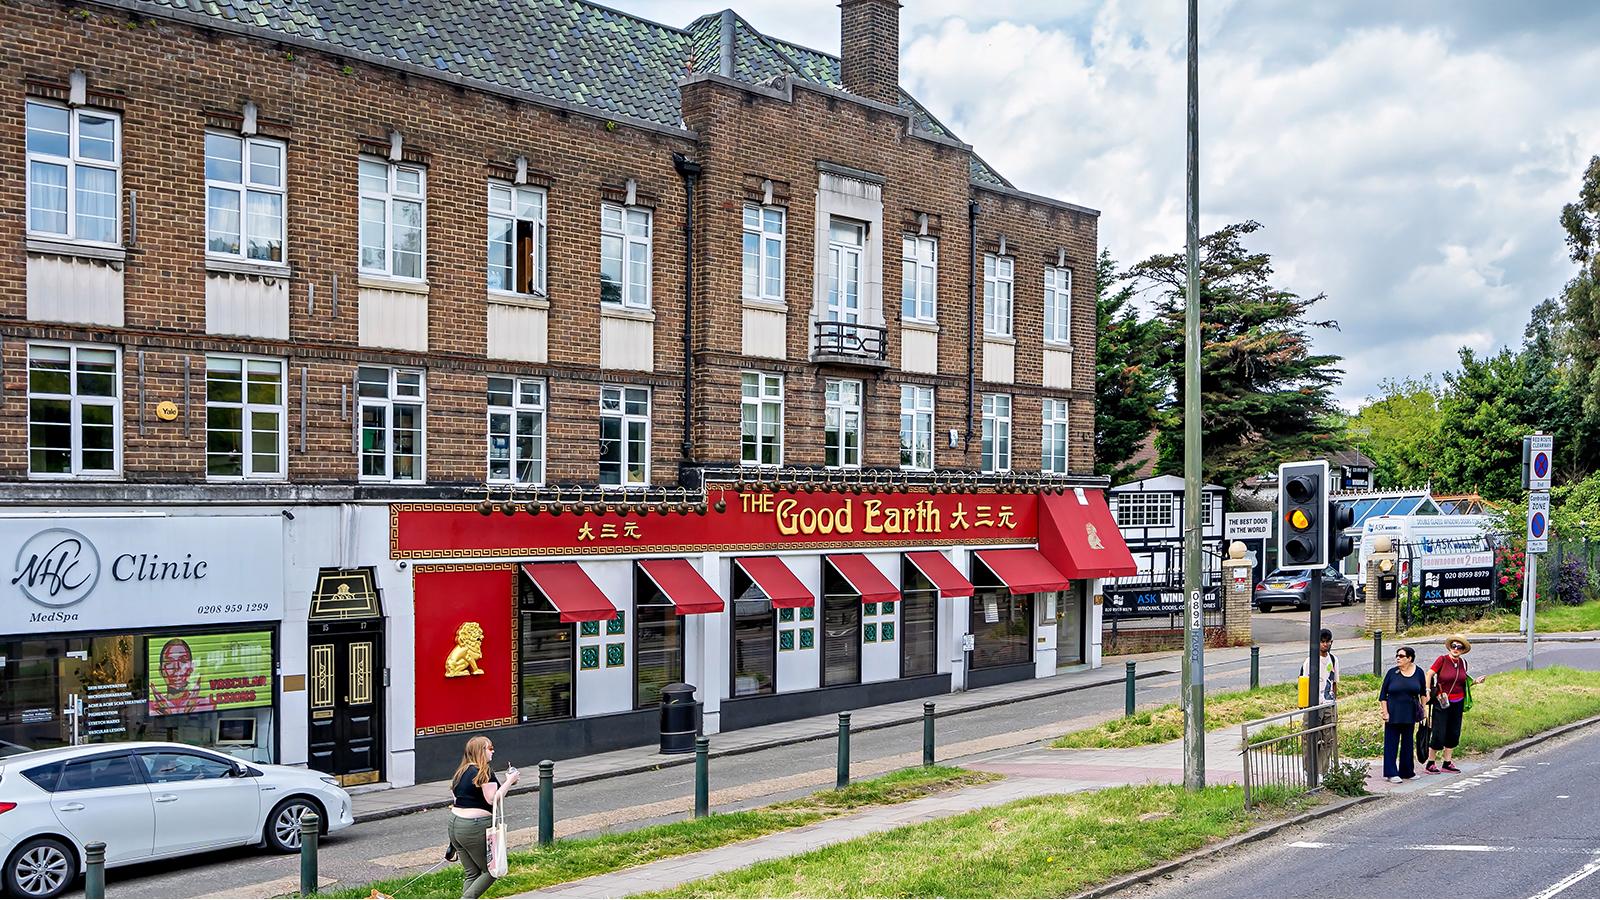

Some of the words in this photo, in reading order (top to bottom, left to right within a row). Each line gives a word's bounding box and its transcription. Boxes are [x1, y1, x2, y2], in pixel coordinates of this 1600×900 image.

[162, 407, 177, 415] Yale
[1532, 502, 1546, 510] ZONE
[740, 493, 774, 513] THE
[776, 499, 853, 535] Good
[863, 499, 941, 533] Earth
[949, 502, 1018, 530] 大三元
[577, 521, 642, 541] 大三元
[1423, 558, 1456, 566] SHOWROOM
[1465, 555, 1471, 566] 2
[1472, 556, 1492, 564] FLOORS
[112, 553, 208, 582] Clinic
[1425, 590, 1441, 598] ASK
[1443, 587, 1480, 598] WINDOWS
[1138, 594, 1157, 604] ASK
[197, 605, 222, 614] 0208
[225, 604, 245, 613] 959
[246, 603, 269, 612] 1299
[1192, 592, 1200, 627] 0894
[29, 612, 79, 623] MedSpa
[322, 623, 329, 631] 15
[361, 621, 367, 629] 17
[209, 676, 267, 690] VASCULAR
[209, 690, 257, 704] LESIONS
